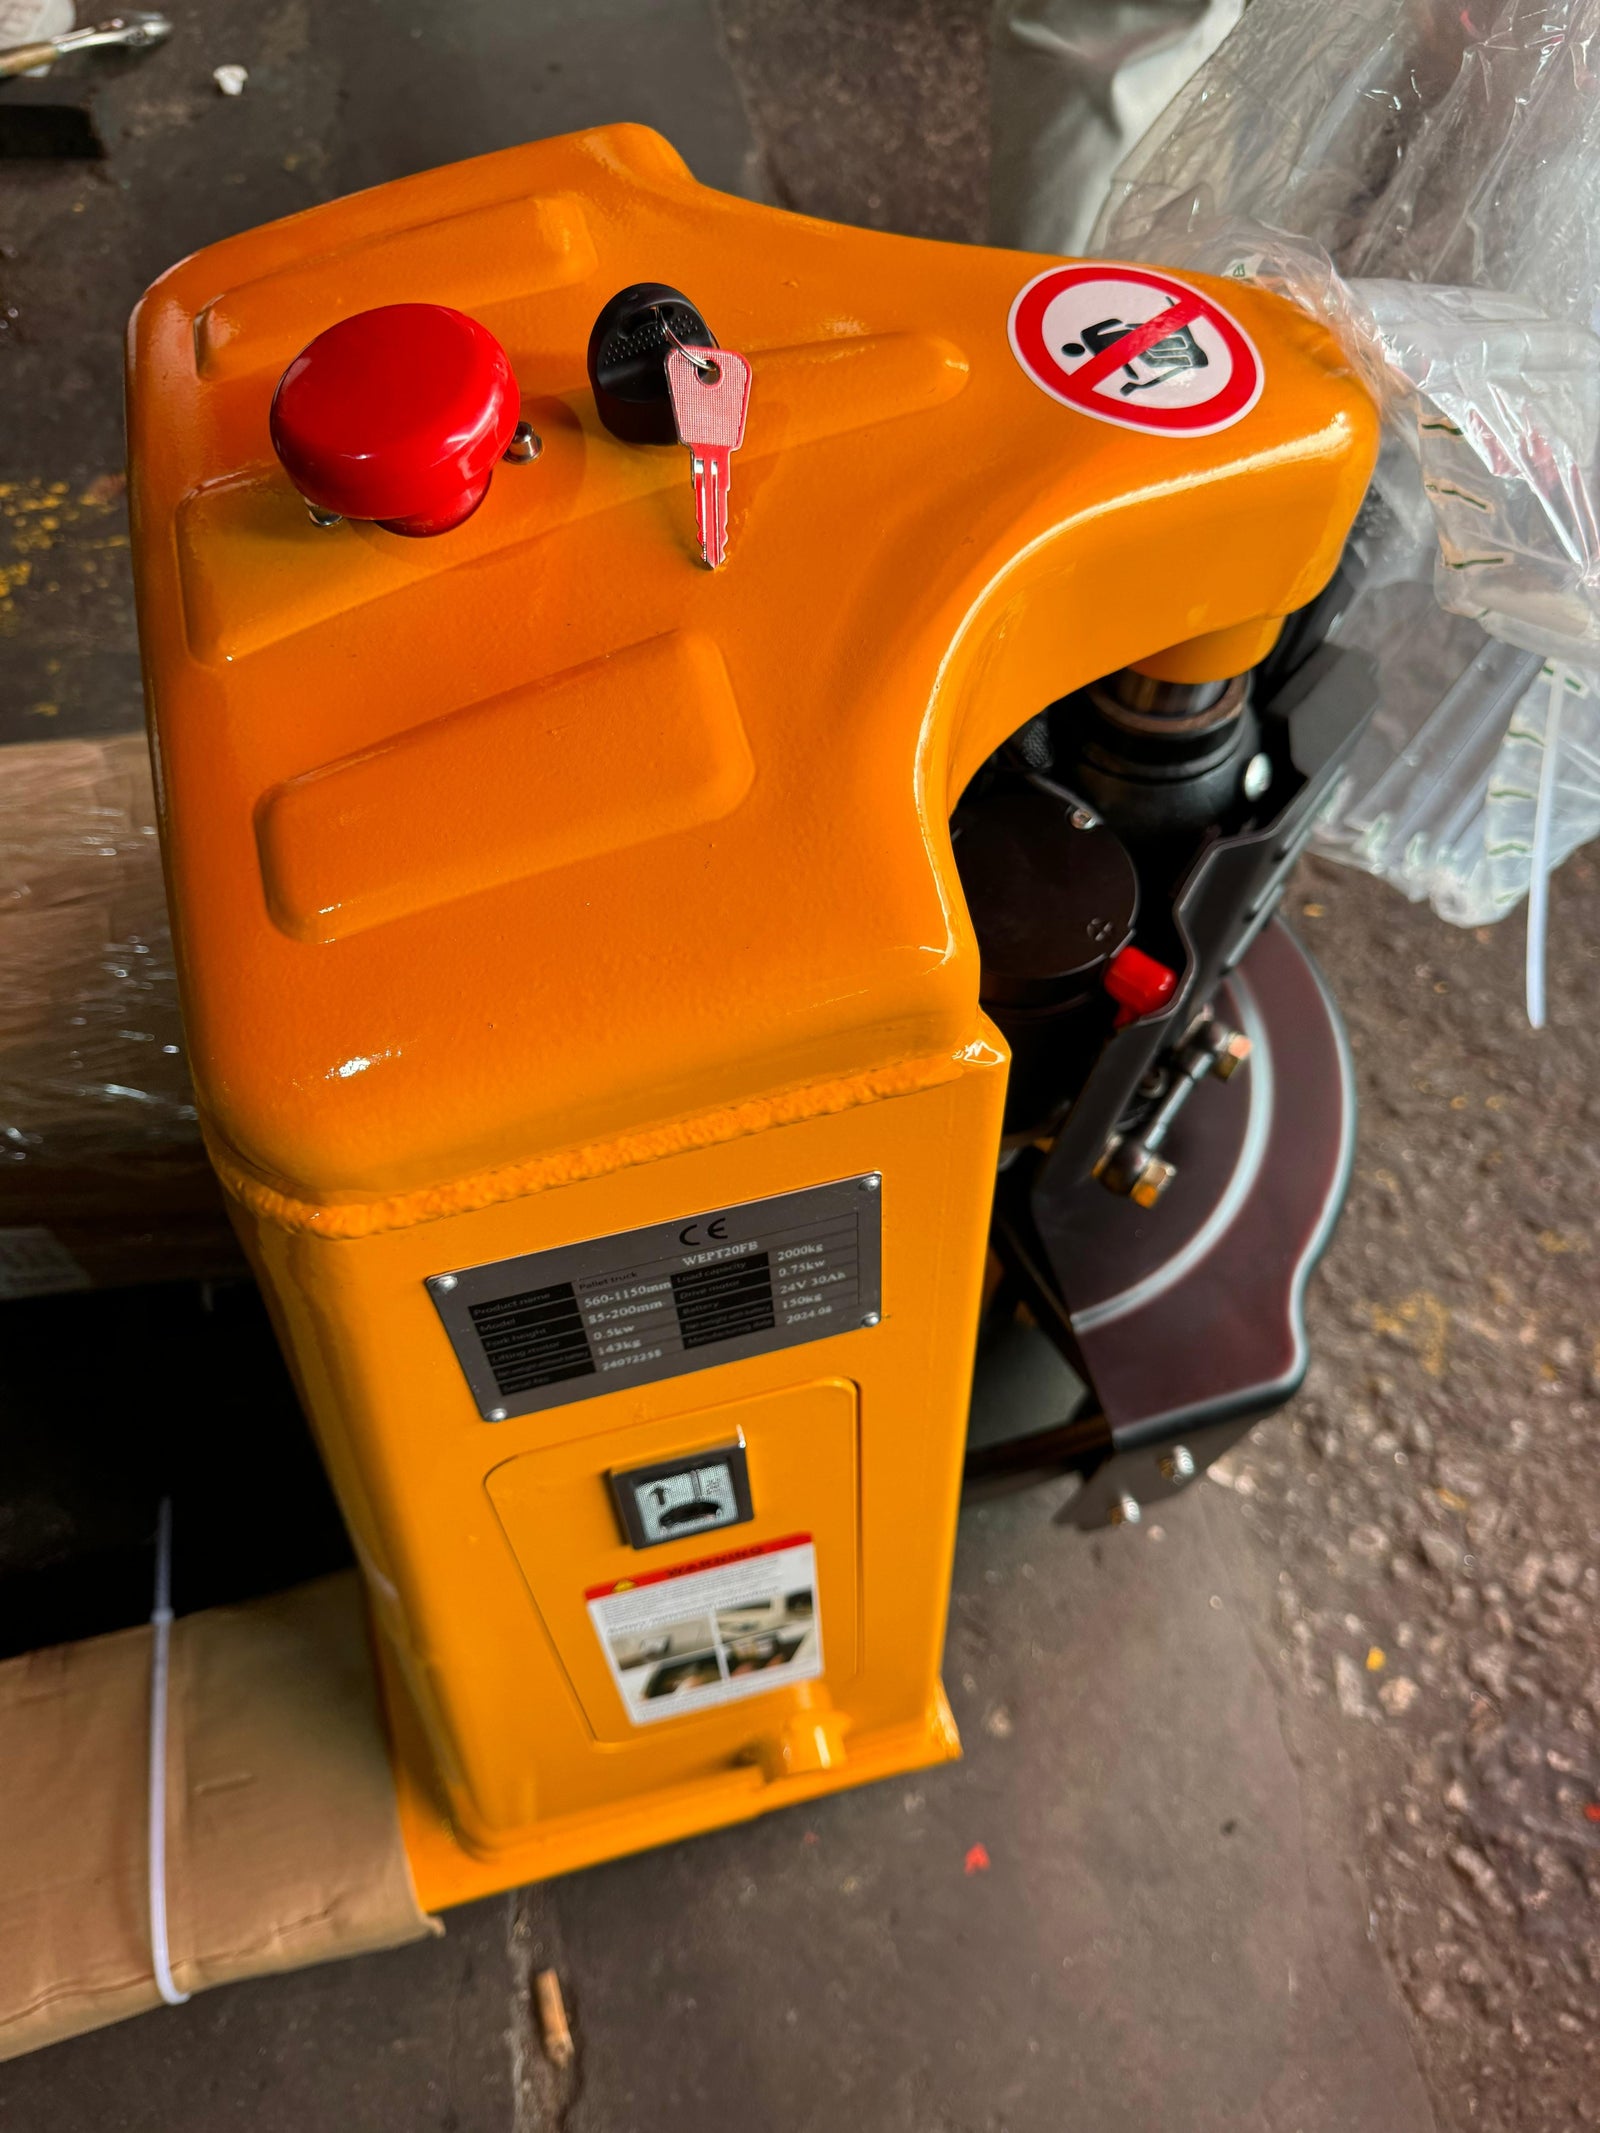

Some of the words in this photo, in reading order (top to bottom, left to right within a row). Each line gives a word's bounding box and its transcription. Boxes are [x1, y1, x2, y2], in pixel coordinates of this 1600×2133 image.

[682, 1241, 759, 1266] WEPT20FB
[778, 1244, 823, 1261] 2000kg
[779, 1260, 825, 1277] 0.75kw
[579, 1280, 608, 1290] Pallet
[611, 1272, 638, 1282] truck
[780, 1280, 807, 1294] 24V
[584, 1281, 671, 1308] 560-1150mm
[588, 1300, 663, 1324] 85-200mm
[594, 1325, 635, 1340] 0.5kw
